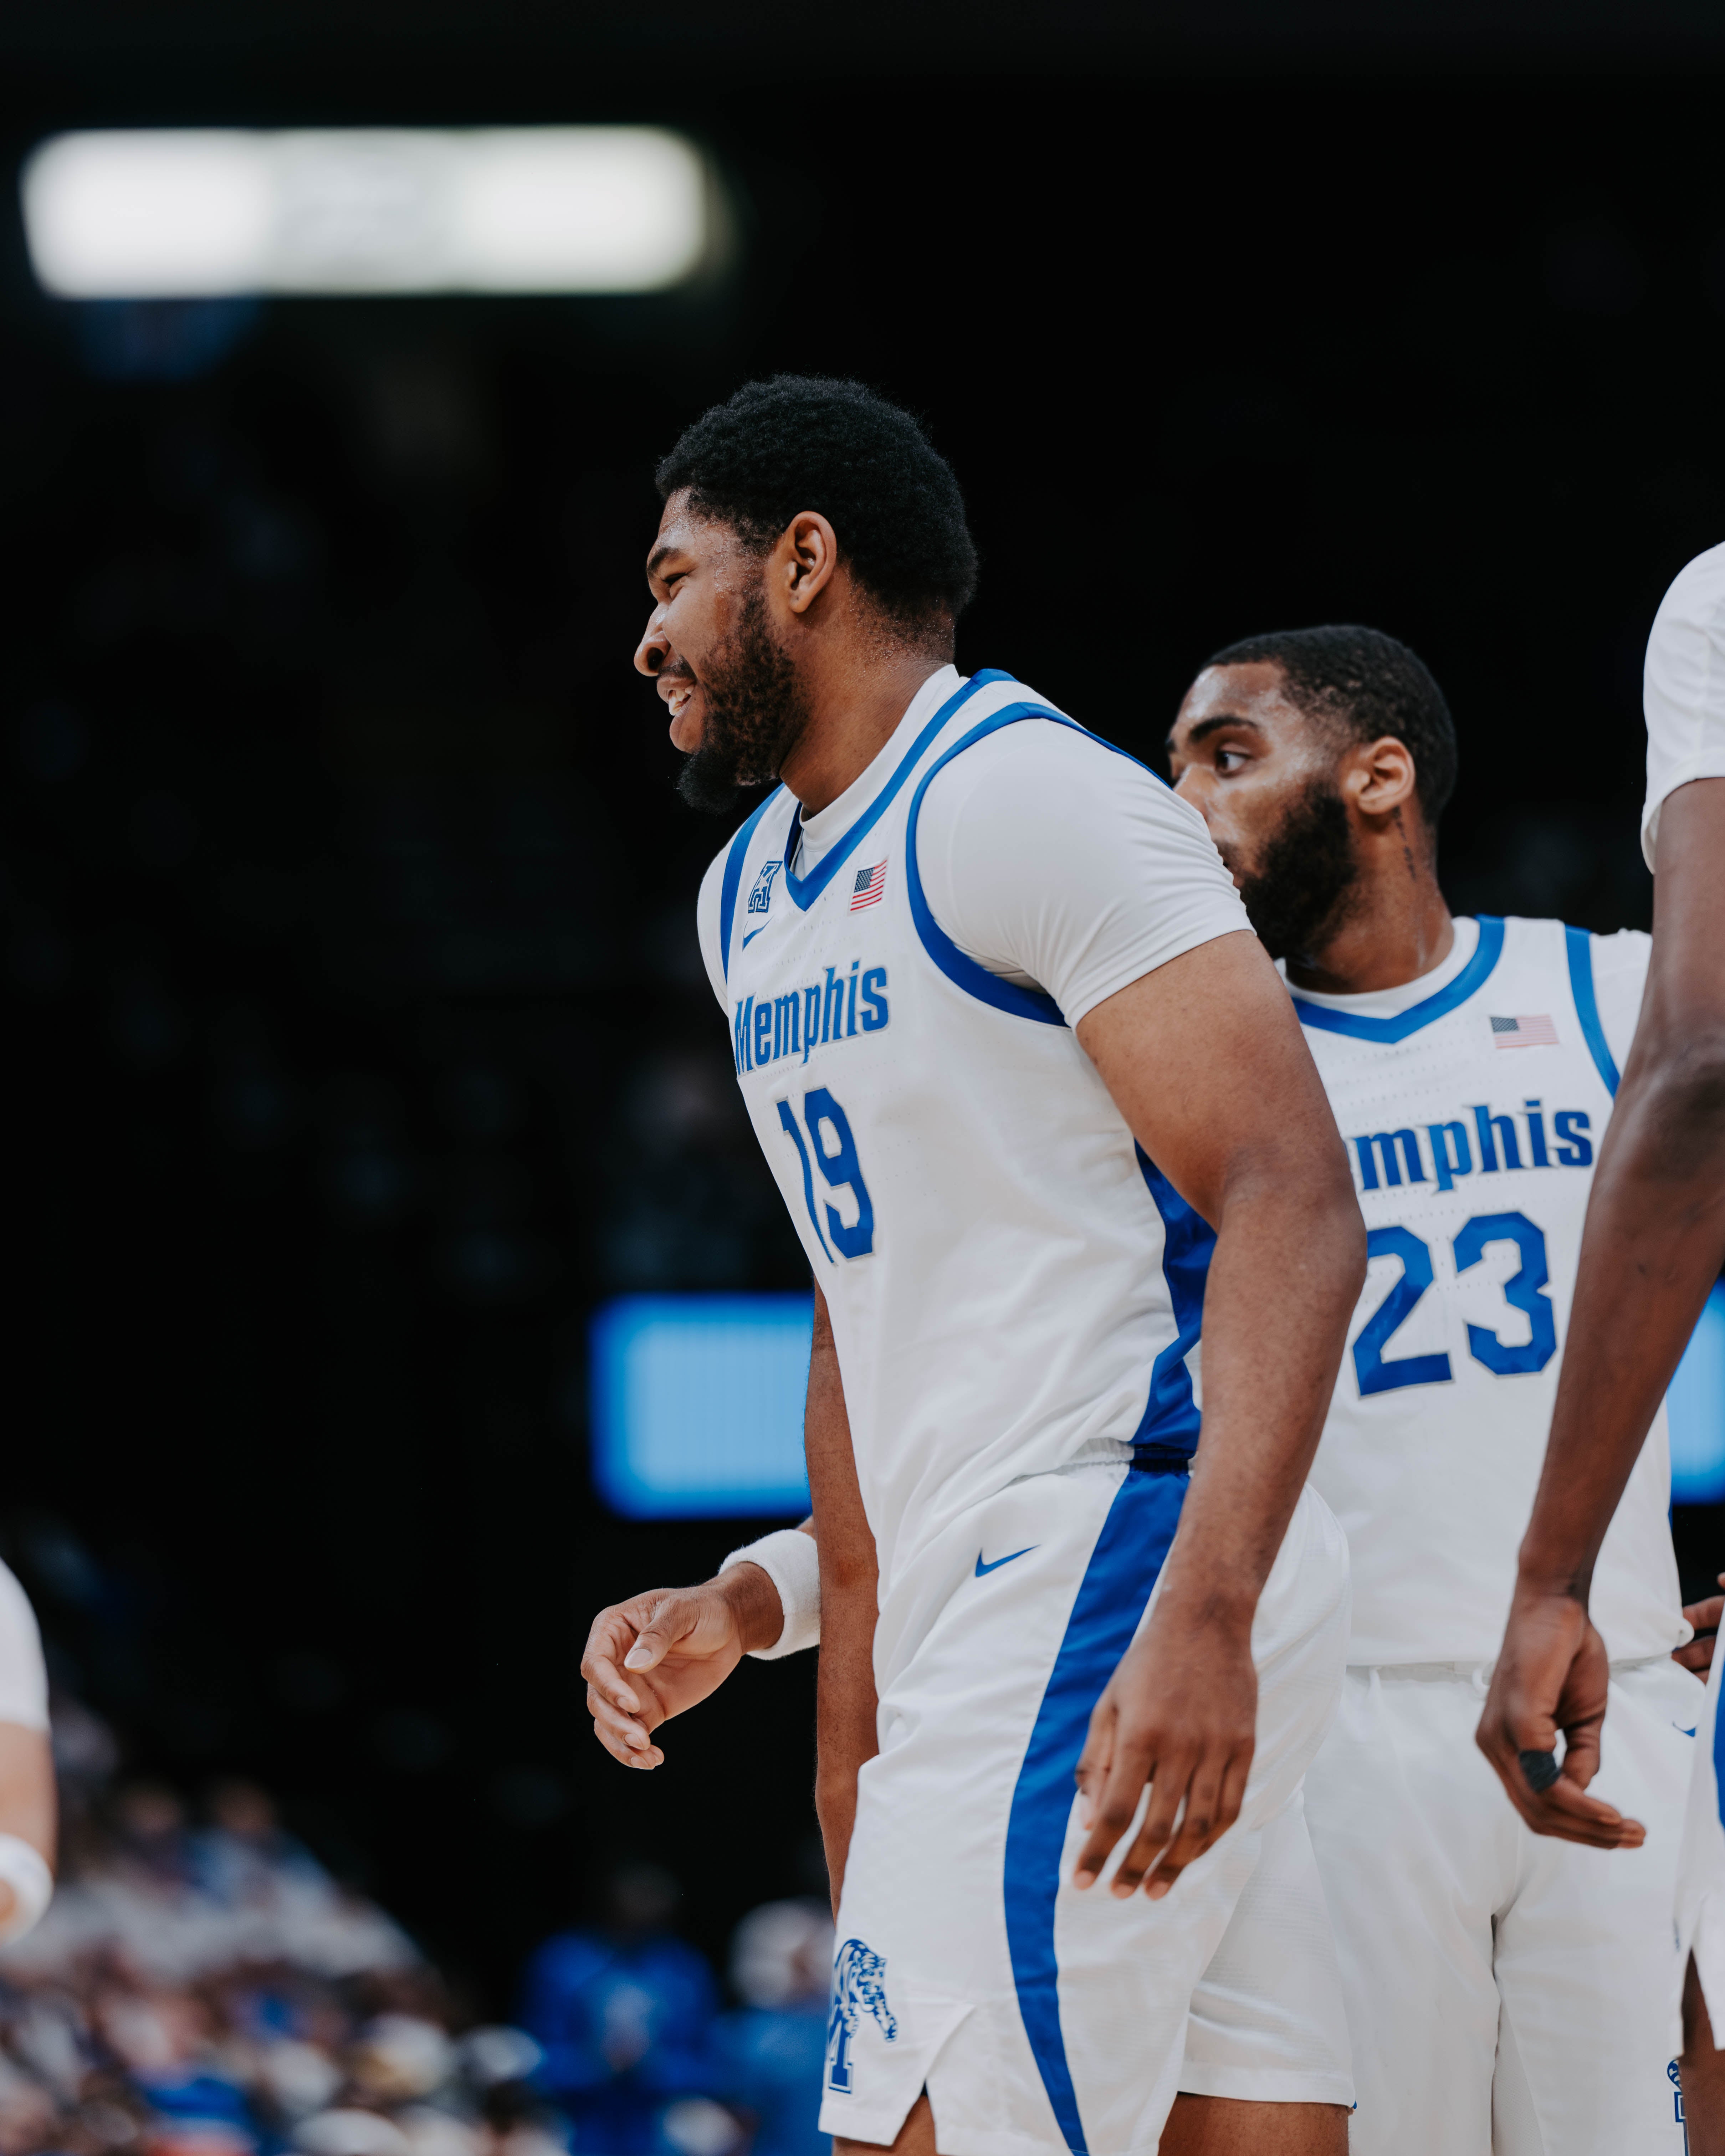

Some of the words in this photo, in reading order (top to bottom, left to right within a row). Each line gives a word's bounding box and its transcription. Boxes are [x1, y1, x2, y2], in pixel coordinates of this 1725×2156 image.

[733, 959, 890, 1077] Memphis
[775, 1086, 875, 1265] 19
[1343, 1099, 1593, 1192] mphis
[1352, 1211, 1557, 1397] 23
